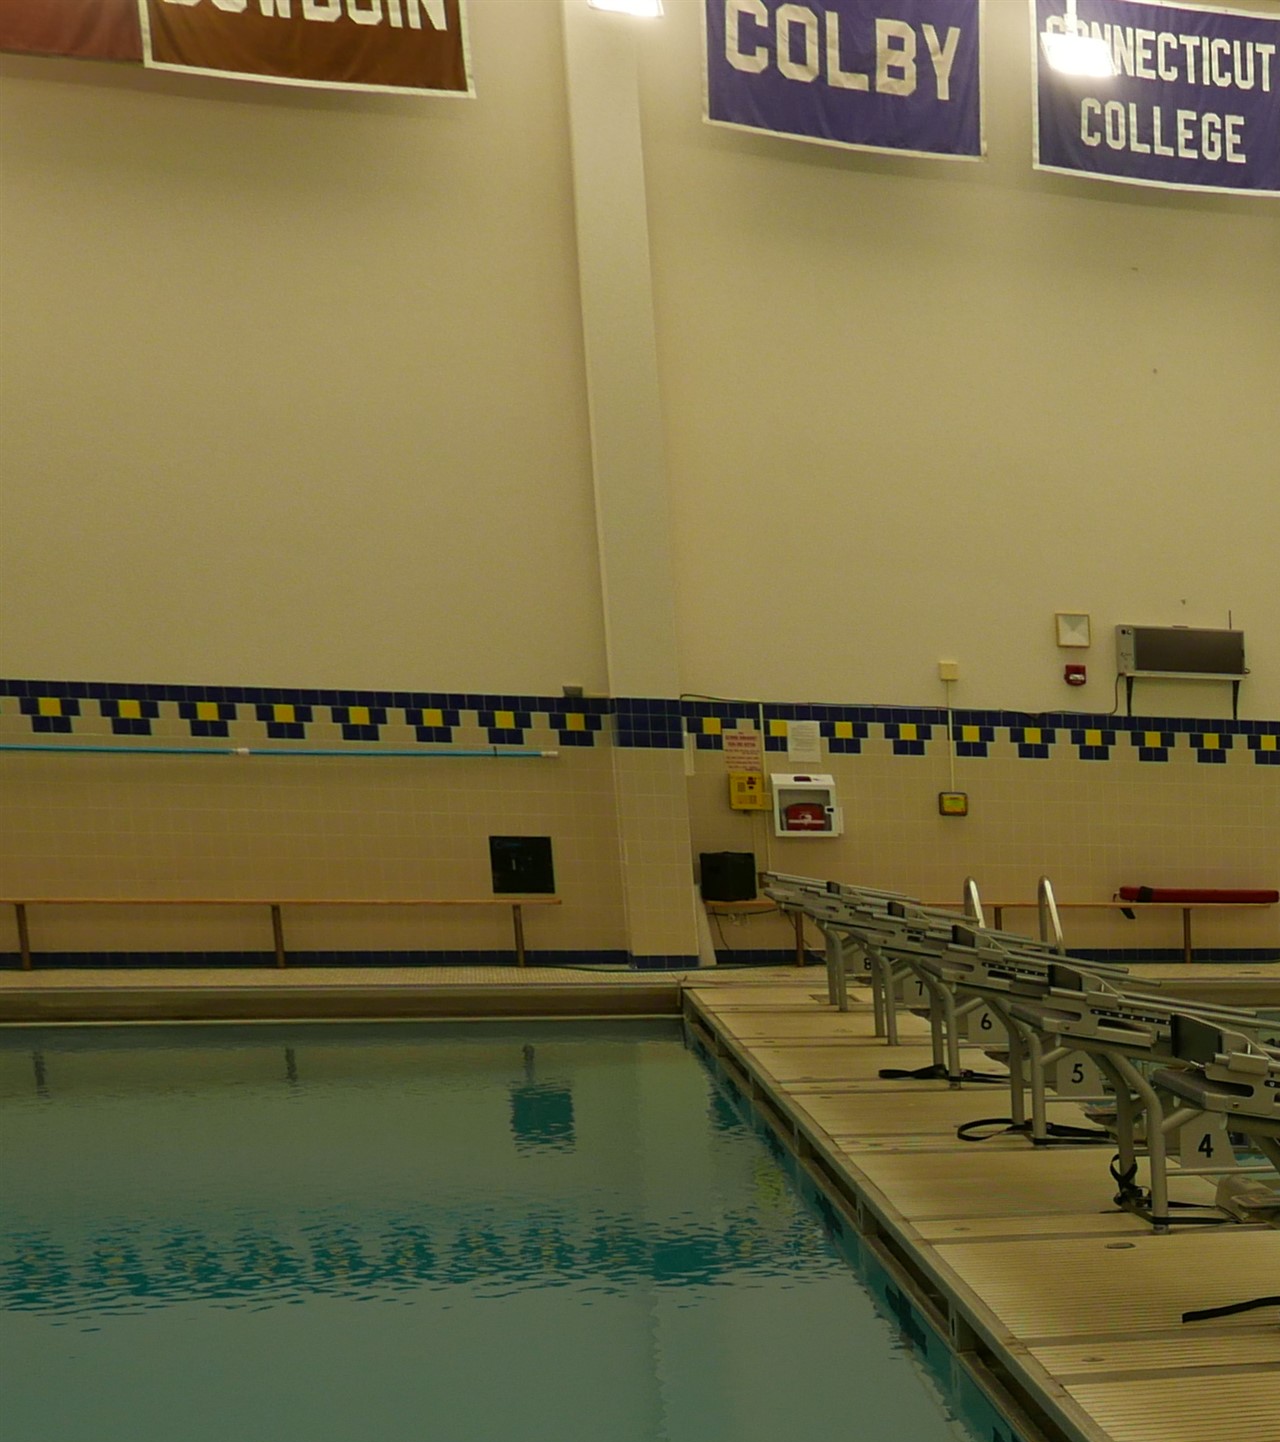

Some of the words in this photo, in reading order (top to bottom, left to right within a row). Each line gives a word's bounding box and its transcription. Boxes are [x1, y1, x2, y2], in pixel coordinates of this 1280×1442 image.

[725, 0, 961, 101] COLBY
[1080, 97, 1247, 164] COLLEGE
[915, 980, 924, 996] 7
[981, 1013, 992, 1030] 6
[1071, 1063, 1084, 1083] 5
[1197, 1133, 1214, 1158] 4
